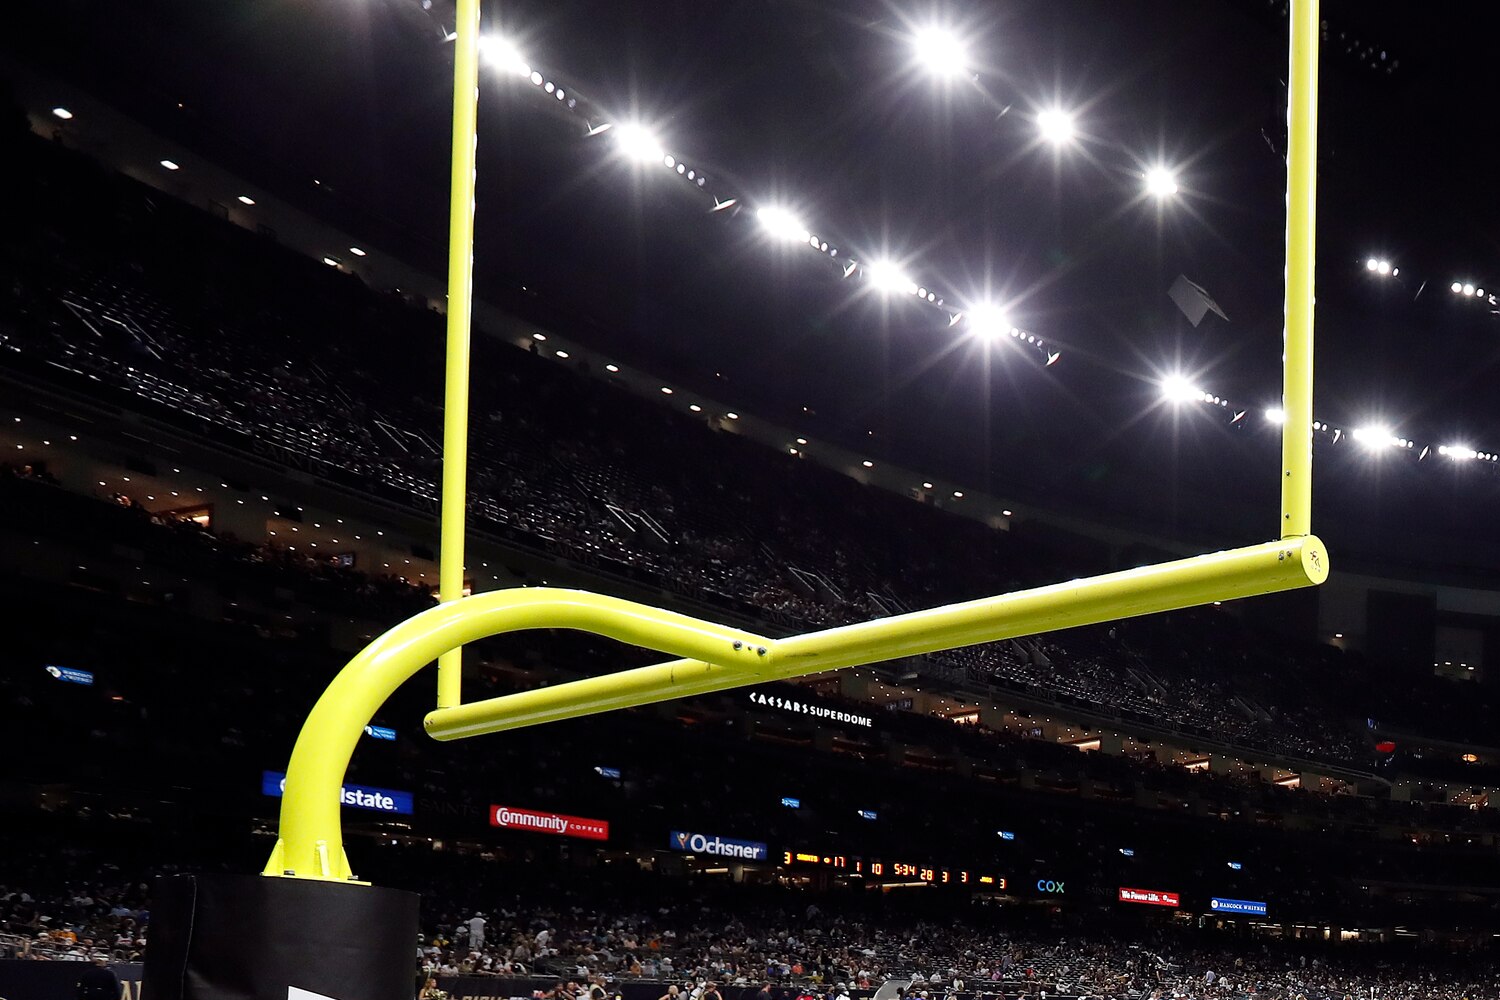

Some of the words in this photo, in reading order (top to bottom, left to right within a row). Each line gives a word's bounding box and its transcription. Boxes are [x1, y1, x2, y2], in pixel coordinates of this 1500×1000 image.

[749, 692, 808, 714] CAESARS
[810, 706, 872, 728] SUPERDOME
[339, 787, 399, 811] lstate.
[496, 807, 568, 833] Community
[570, 823, 604, 833] COFFEE
[690, 834, 760, 859] Ochsner
[784, 851, 791, 865] 3
[834, 856, 845, 867] 17
[872, 863, 882, 875] 10
[894, 863, 916, 876] 5:34
[920, 869, 933, 880] 28
[942, 871, 948, 883] 3
[961, 871, 967, 883] 3
[1000, 878, 1005, 889] 3
[1037, 879, 1065, 894] COX
[1220, 902, 1242, 910] HANCOCK
